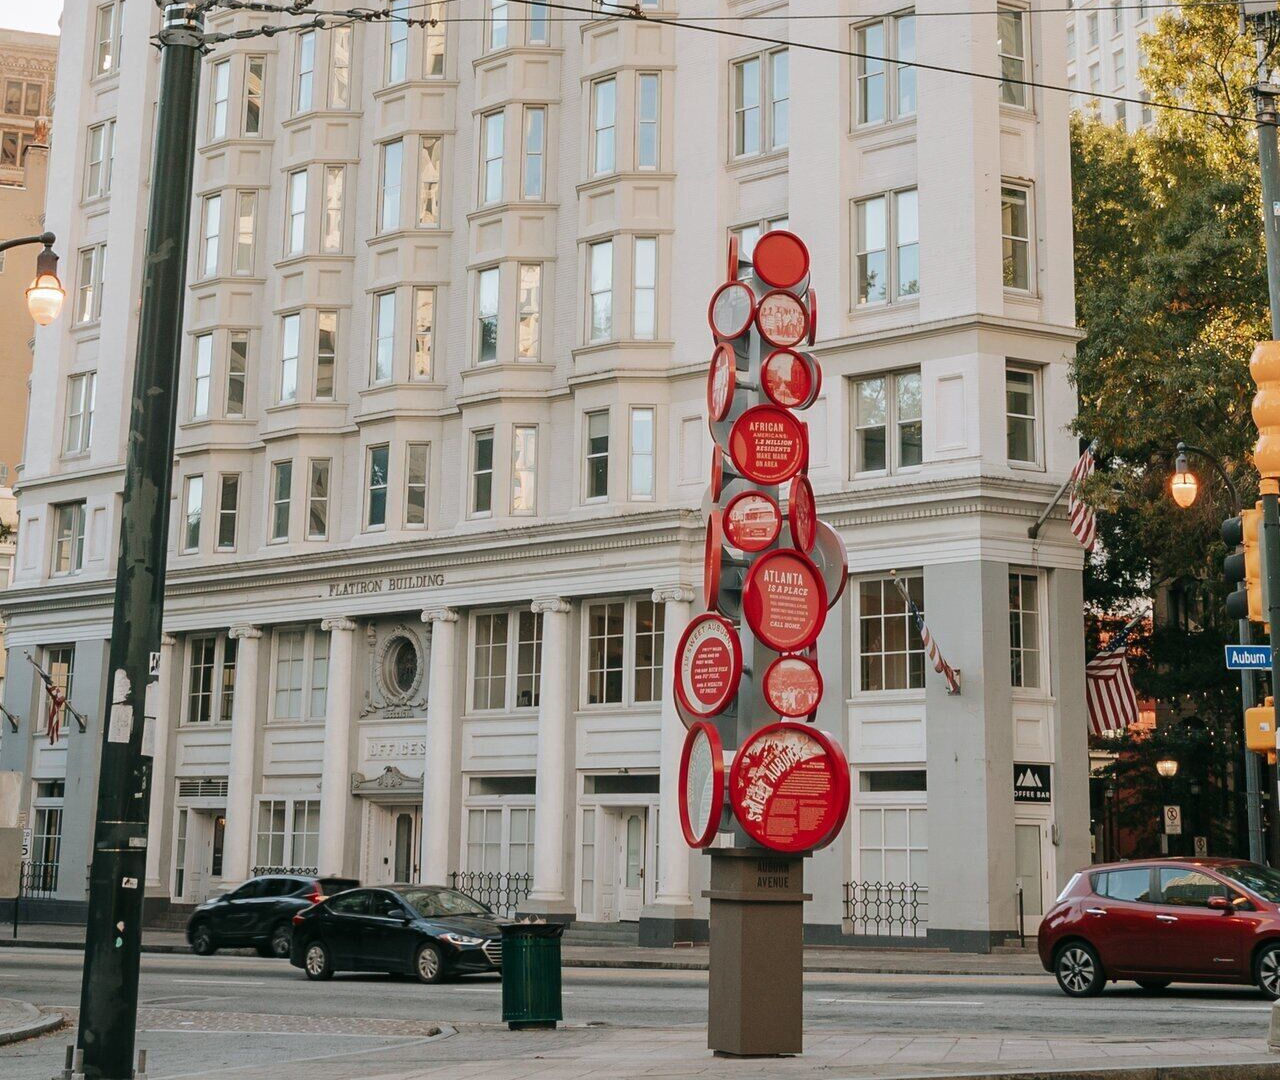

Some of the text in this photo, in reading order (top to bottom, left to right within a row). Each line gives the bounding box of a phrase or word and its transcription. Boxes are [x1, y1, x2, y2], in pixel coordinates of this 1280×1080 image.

[749, 422, 784, 432] AFRICAN
[763, 570, 803, 585] ATLANTA
[328, 575, 444, 597] FLATIRON BUILDING
[767, 584, 775, 592] IS
[783, 587, 808, 596] PLACE
[1231, 650, 1266, 664] Auburn
[369, 743, 426, 756] OFFICES
[1014, 790, 1034, 798] OFFEE
[757, 862, 789, 873] AUBURN
[757, 876, 789, 888] AVENUE
